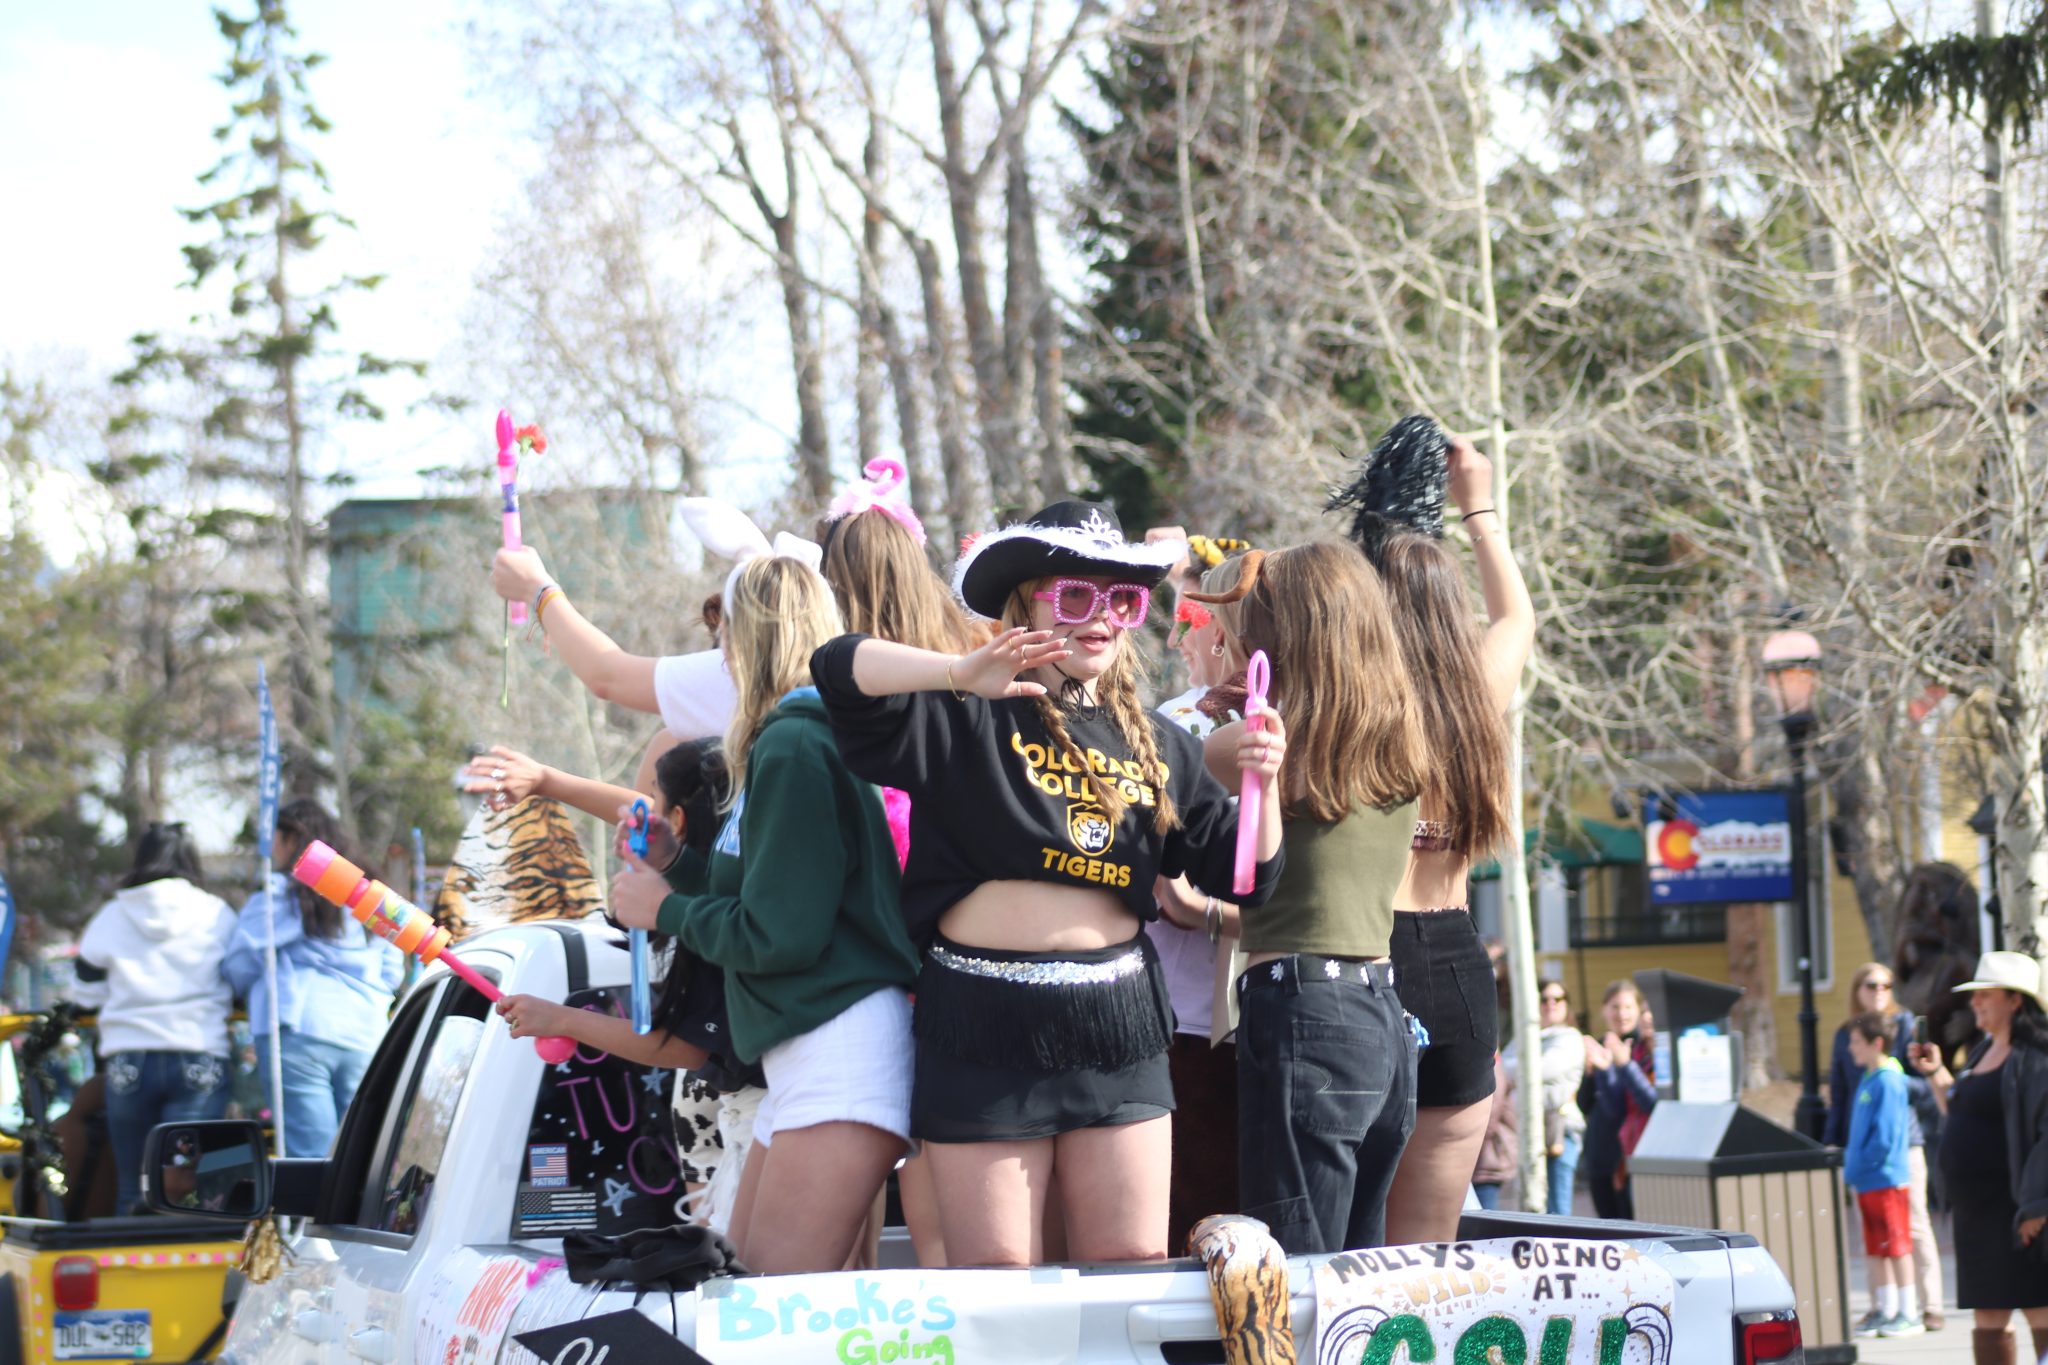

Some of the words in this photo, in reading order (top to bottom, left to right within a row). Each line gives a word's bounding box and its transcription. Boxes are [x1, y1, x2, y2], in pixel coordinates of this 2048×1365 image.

[1026, 765, 1157, 807] COLLGE
[1042, 847, 1131, 888] TIGERS
[530, 1146, 567, 1155] AMERICAN
[531, 1176, 567, 1188] PATRIOT
[1328, 1243, 1476, 1284] MOLLYS
[1512, 1240, 1621, 1271] GOING
[1402, 1271, 1492, 1306] WILD
[837, 1327, 955, 1365] Going
